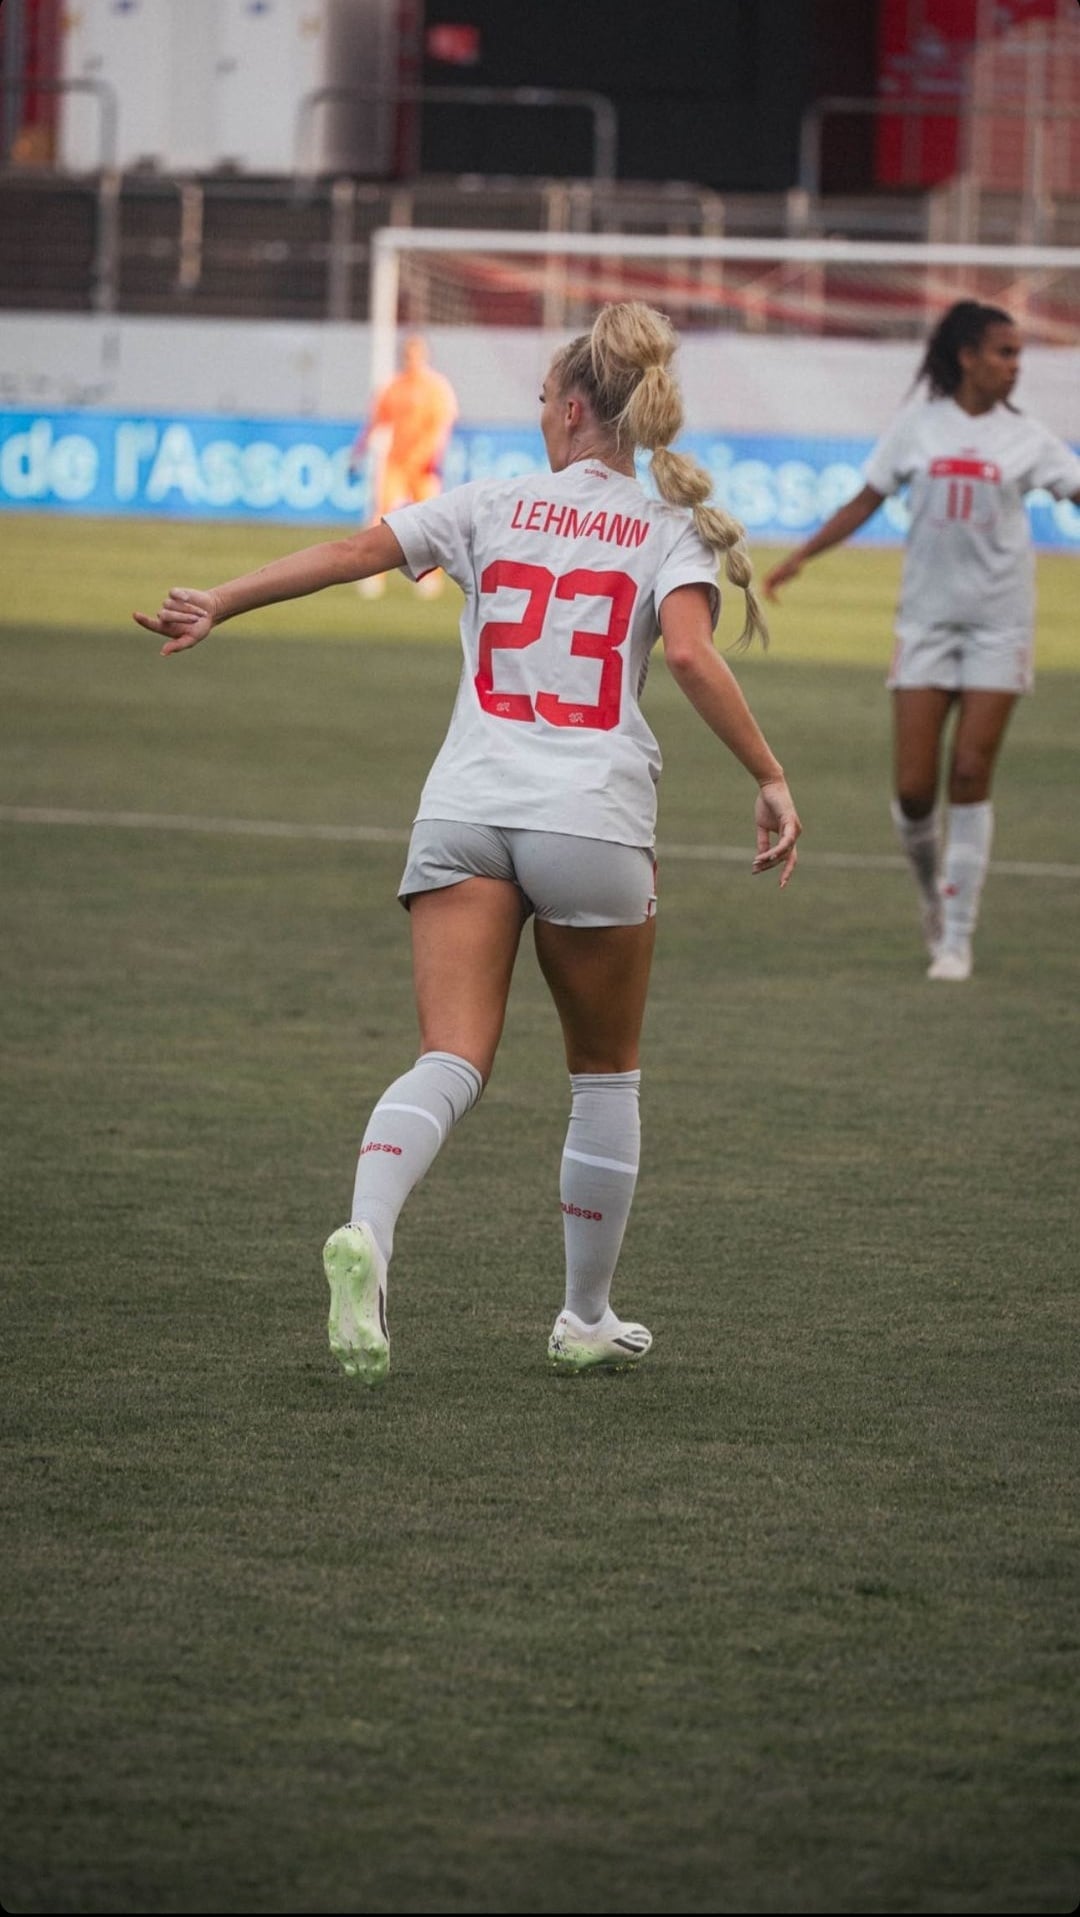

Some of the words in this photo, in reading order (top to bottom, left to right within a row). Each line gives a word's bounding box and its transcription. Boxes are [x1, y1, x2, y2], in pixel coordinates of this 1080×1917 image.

[2, 419, 98, 499] de
[510, 499, 650, 548] LEHMANN
[474, 559, 638, 731] 23
